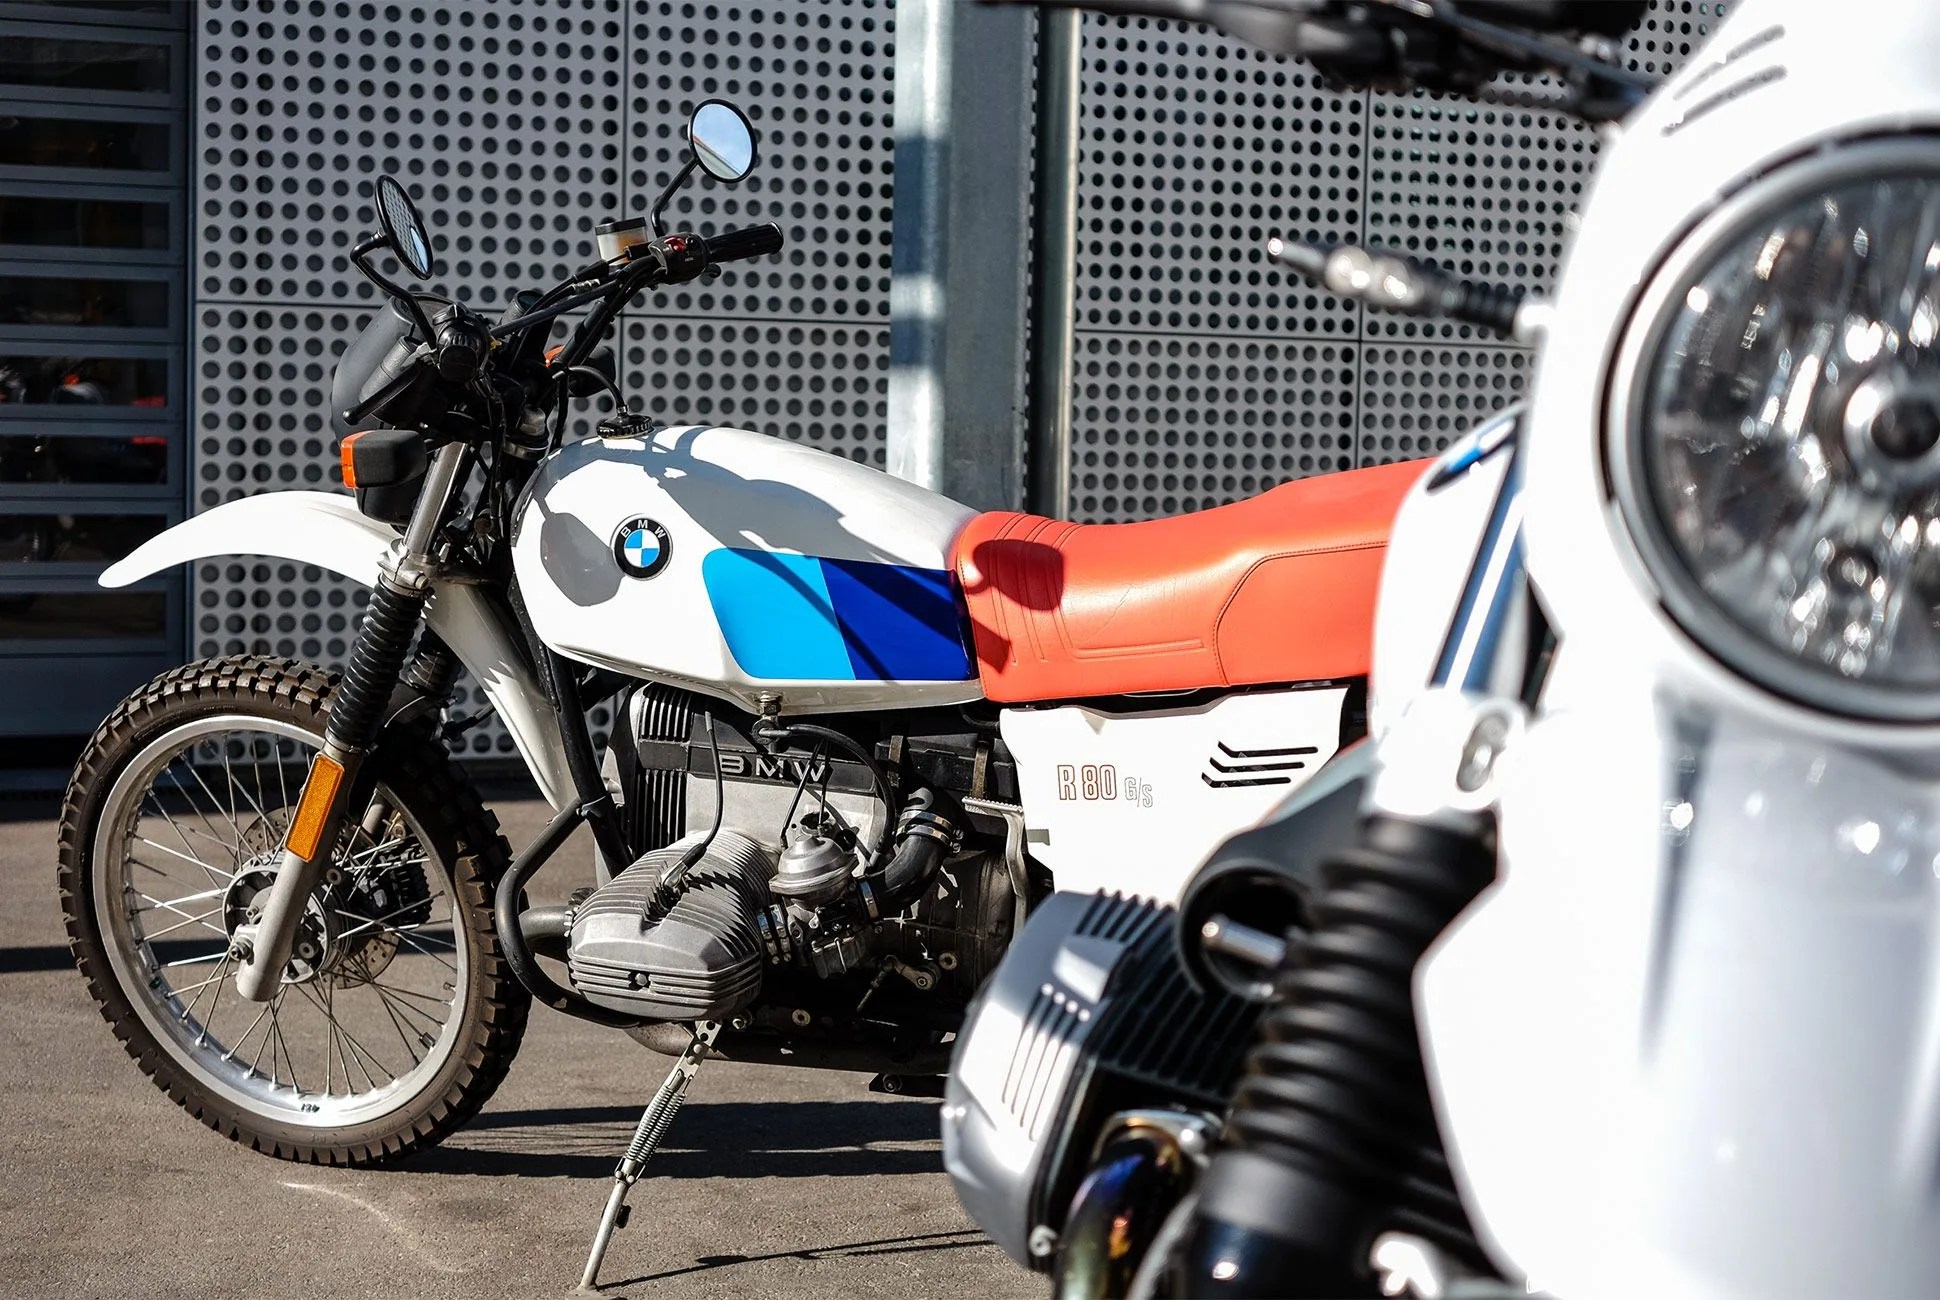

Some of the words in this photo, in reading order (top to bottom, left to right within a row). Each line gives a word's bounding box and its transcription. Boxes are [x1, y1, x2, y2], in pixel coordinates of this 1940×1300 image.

[620, 519, 667, 539] BMW
[719, 754, 827, 782] BMW
[1057, 764, 1077, 801] R
[1081, 764, 1118, 801] 80
[1124, 776, 1154, 808] G/S
